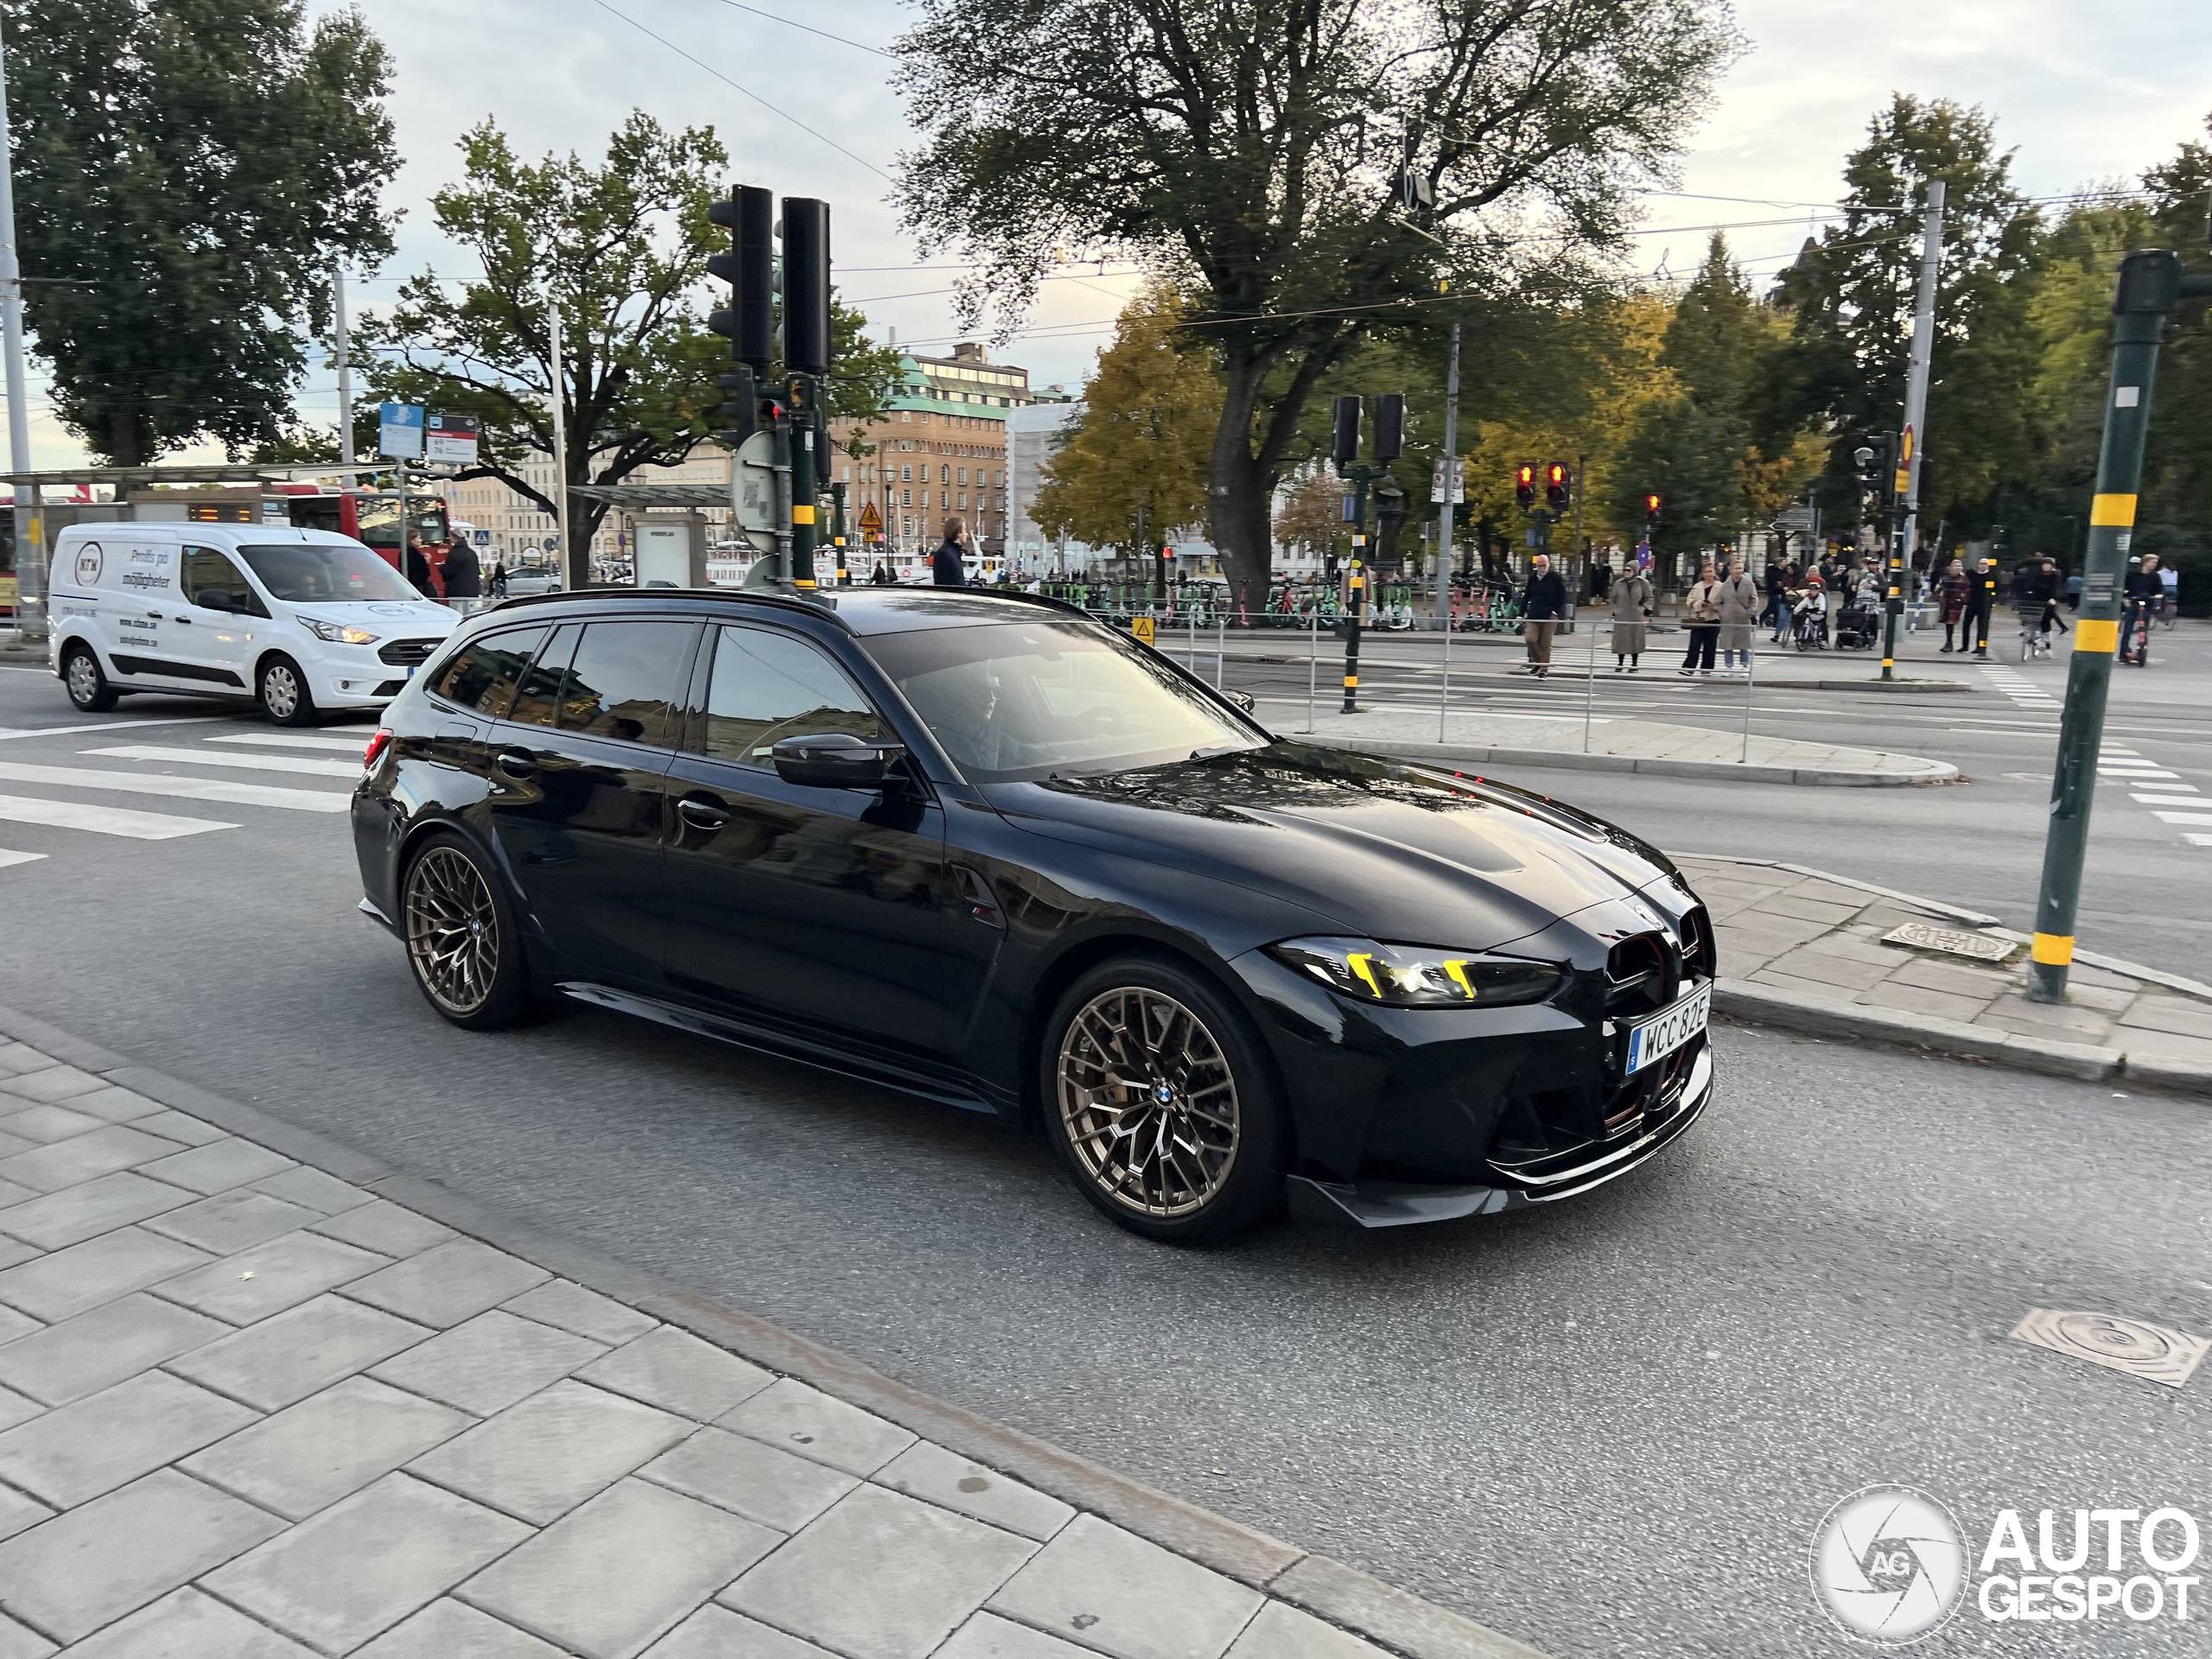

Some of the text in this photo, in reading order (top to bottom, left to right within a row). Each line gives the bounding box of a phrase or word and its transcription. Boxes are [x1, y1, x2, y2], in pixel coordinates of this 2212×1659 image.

[1645, 995, 1707, 1061] WCC 82E
[1630, 1055, 1636, 1066] S
